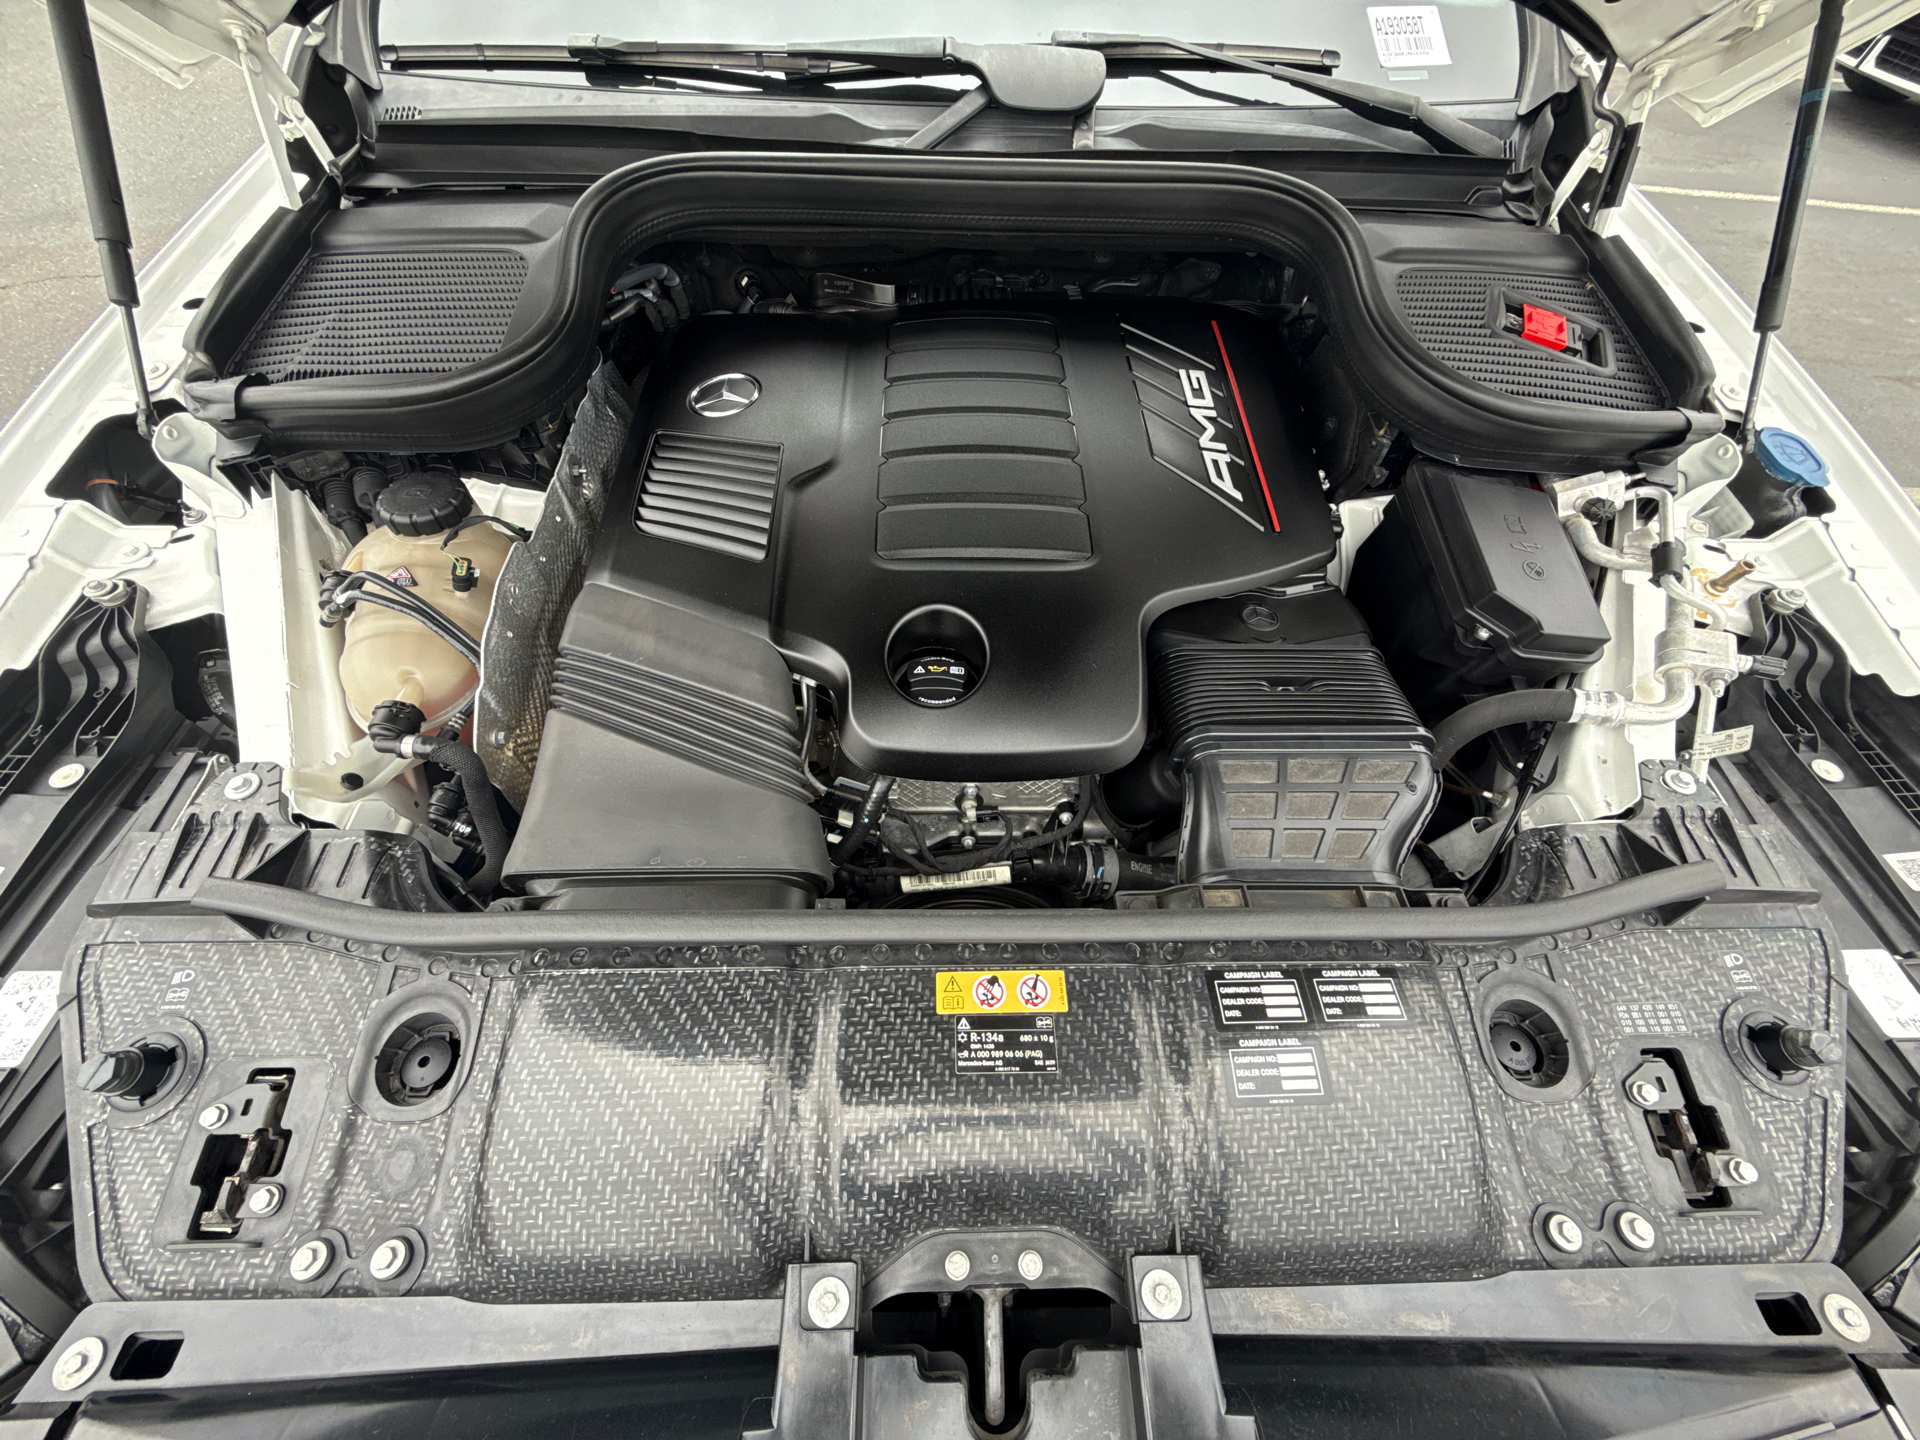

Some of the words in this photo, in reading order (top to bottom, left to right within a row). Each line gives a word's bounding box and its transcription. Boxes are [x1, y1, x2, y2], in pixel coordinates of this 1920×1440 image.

[1375, 15, 1425, 36] A193058T
[1178, 368, 1243, 501] AMG
[454, 822, 471, 834] TOP
[1130, 860, 1153, 875] ENGINE
[1224, 971, 1261, 979] CAMPAIGN
[1220, 986, 1250, 994] CAMPAIGN
[970, 1032, 1004, 1042] R-134a
[1239, 1039, 1277, 1047] CAMPAIGN
[1278, 1038, 1301, 1046] LABEL
[1025, 1050, 1042, 1058] (PAG)
[1234, 1056, 1265, 1064] CAMPAIGN
[1266, 1055, 1277, 1063] NO:
[1236, 1069, 1260, 1077] DEALER
[1261, 1068, 1280, 1076] CODE:
[1238, 1082, 1256, 1090] DATE:
